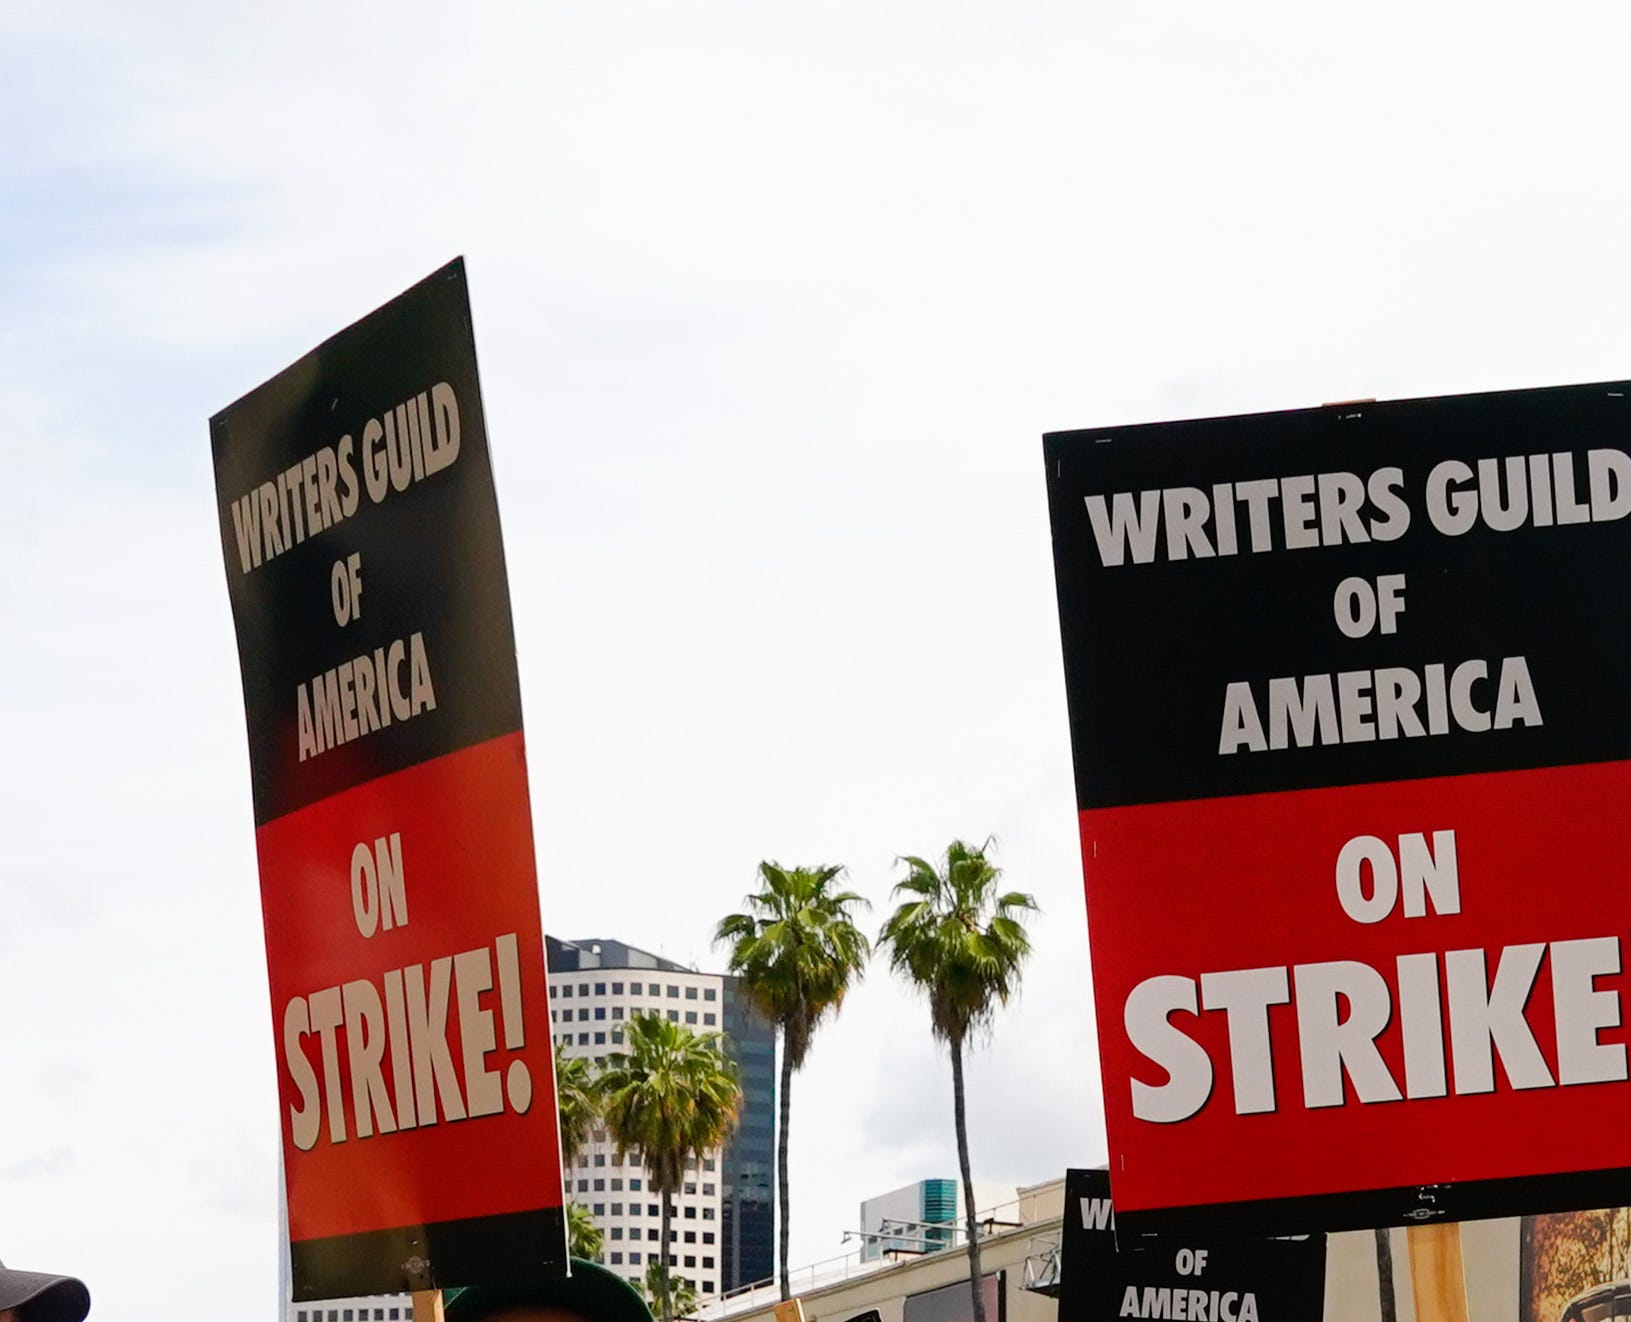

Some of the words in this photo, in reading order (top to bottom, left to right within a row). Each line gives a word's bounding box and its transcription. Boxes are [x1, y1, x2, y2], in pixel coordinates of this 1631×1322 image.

[231, 434, 359, 575] WRITERS
[365, 381, 461, 503] GUILD
[1084, 467, 1411, 567] WRITERS
[330, 551, 363, 628] OF
[1333, 574, 1406, 639] OF
[298, 631, 436, 763] AMERICA
[1218, 656, 1544, 756] AMERICA
[350, 832, 408, 939] ON
[1335, 830, 1461, 925] ON
[283, 933, 532, 1150] STRIKE!
[1175, 1248, 1207, 1277] OF
